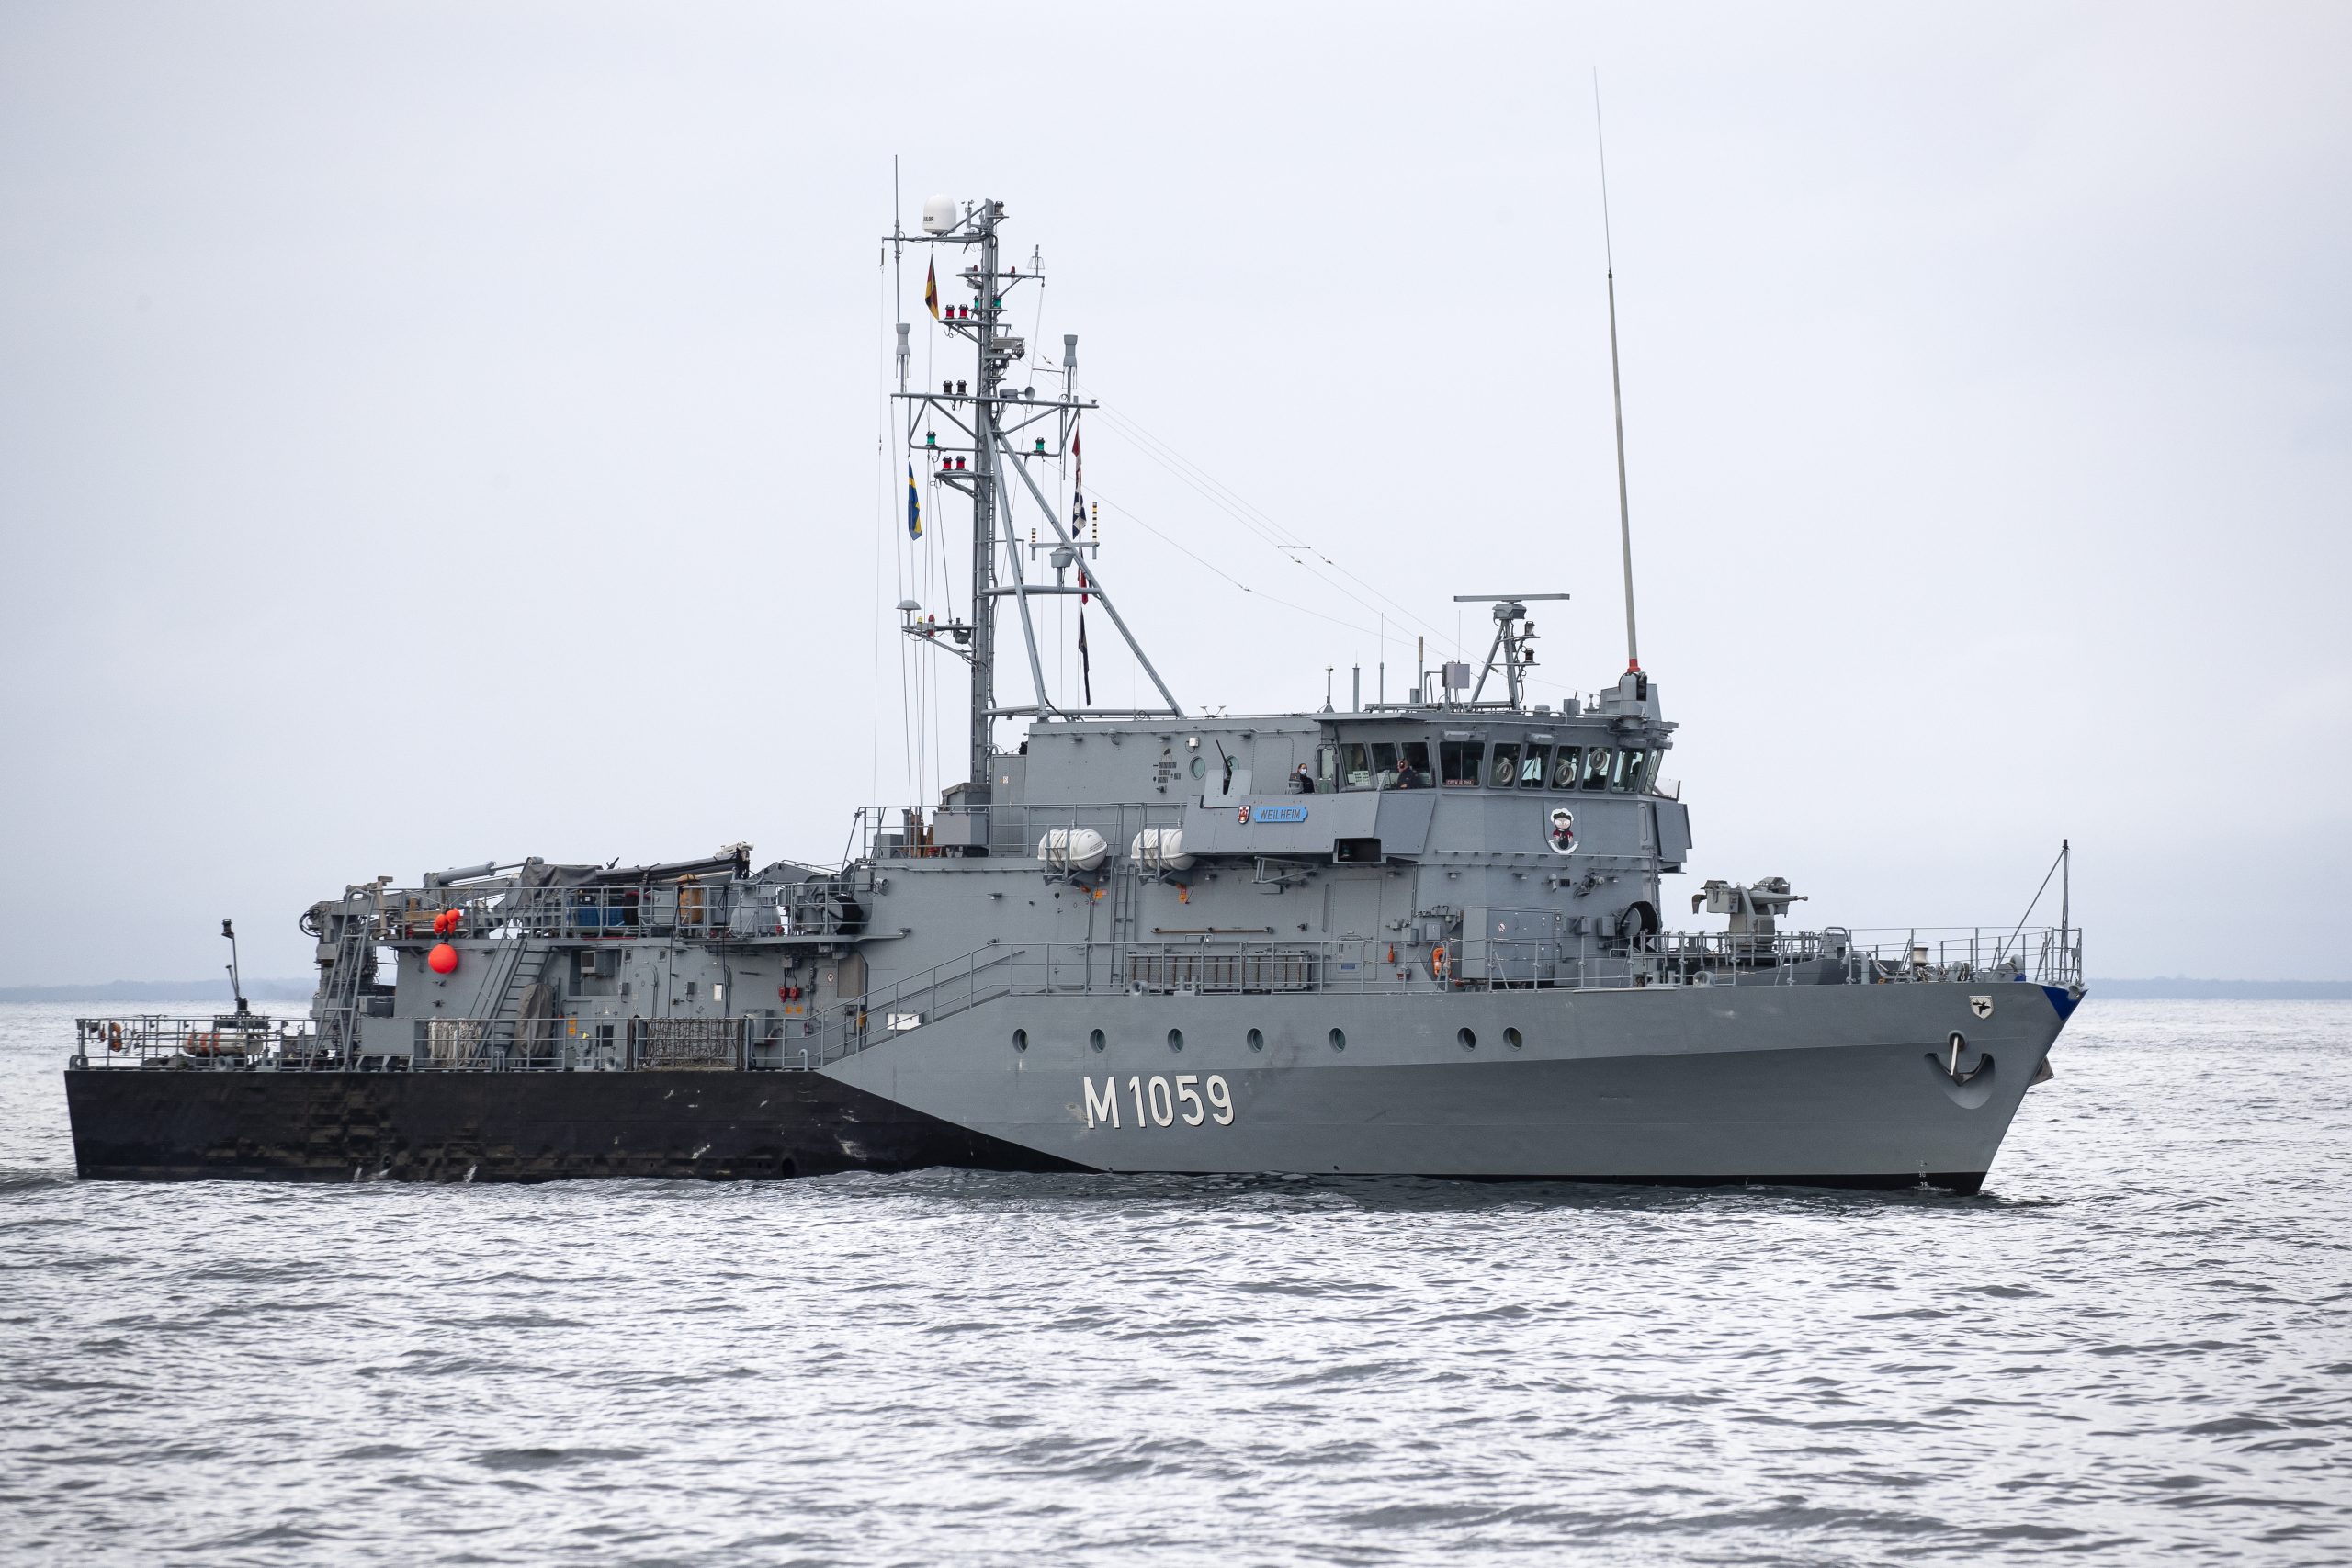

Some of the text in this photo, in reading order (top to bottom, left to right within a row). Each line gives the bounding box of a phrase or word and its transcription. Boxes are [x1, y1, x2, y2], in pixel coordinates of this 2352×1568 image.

[1260, 809, 1302, 820] WEILHEIM
[1083, 1074, 1235, 1129] M 1059
